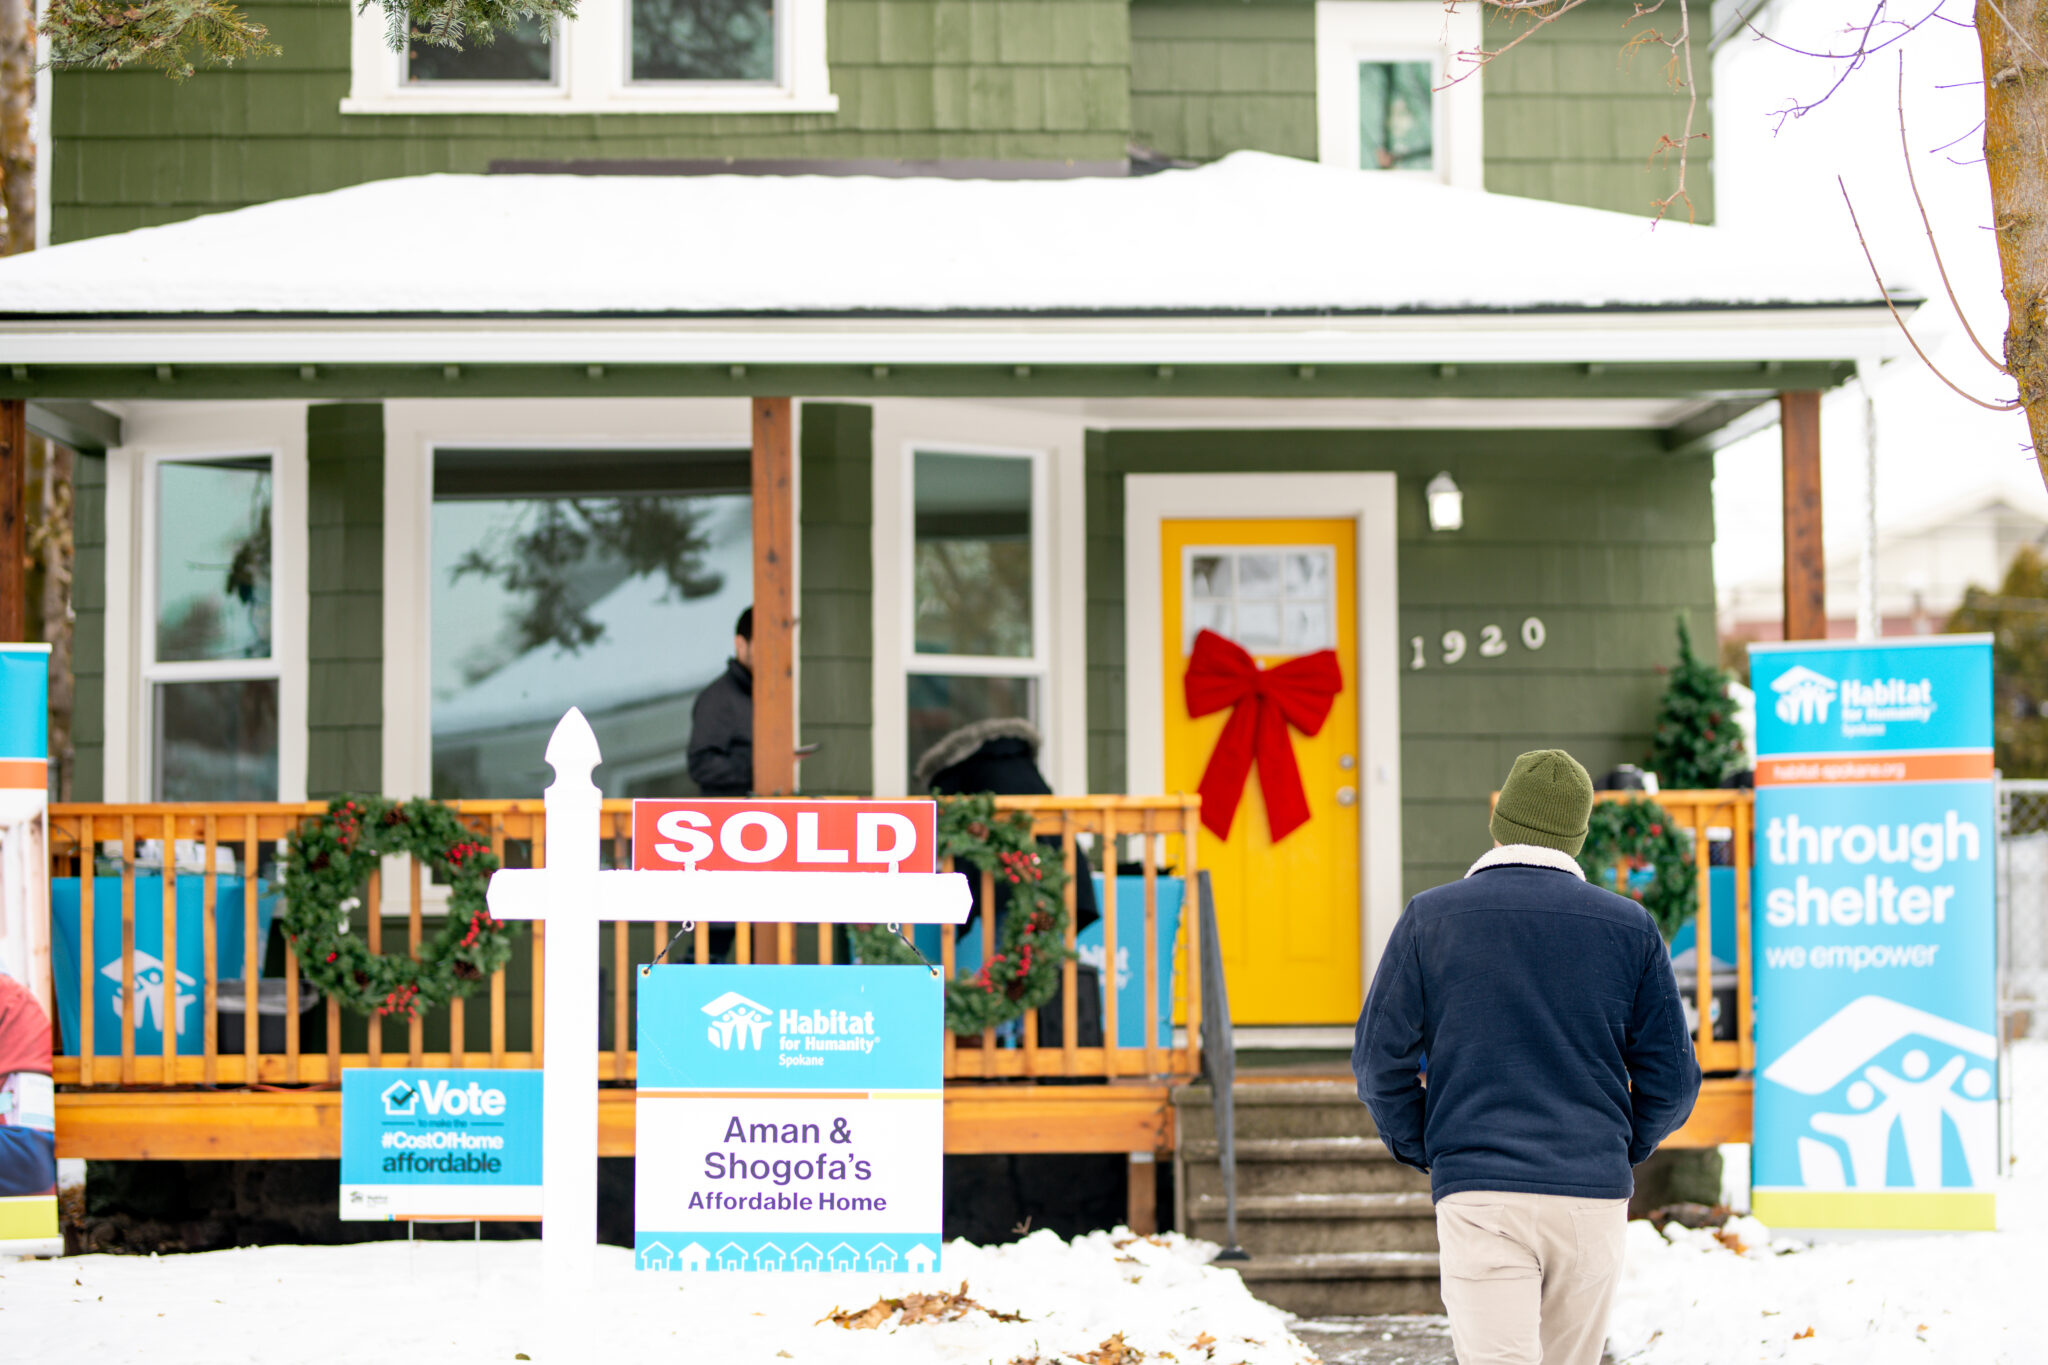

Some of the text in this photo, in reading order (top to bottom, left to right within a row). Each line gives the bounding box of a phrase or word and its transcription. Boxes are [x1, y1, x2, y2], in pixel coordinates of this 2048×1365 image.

[1410, 617, 1547, 670] 1920
[1841, 678, 1932, 706] Habitat
[654, 811, 917, 864] SOLD
[1766, 810, 1980, 873] through
[1766, 875, 1954, 927] shelter
[1766, 944, 1940, 973] we empower
[779, 1009, 875, 1035] Habitat
[779, 1036, 801, 1051] for
[779, 1053, 825, 1068] Spokane
[417, 1080, 506, 1116] Vote
[381, 1131, 505, 1150] #CostOfHome
[723, 1116, 852, 1144] Aman &
[382, 1152, 502, 1174] affordable
[687, 1191, 888, 1212] Affordable Home
